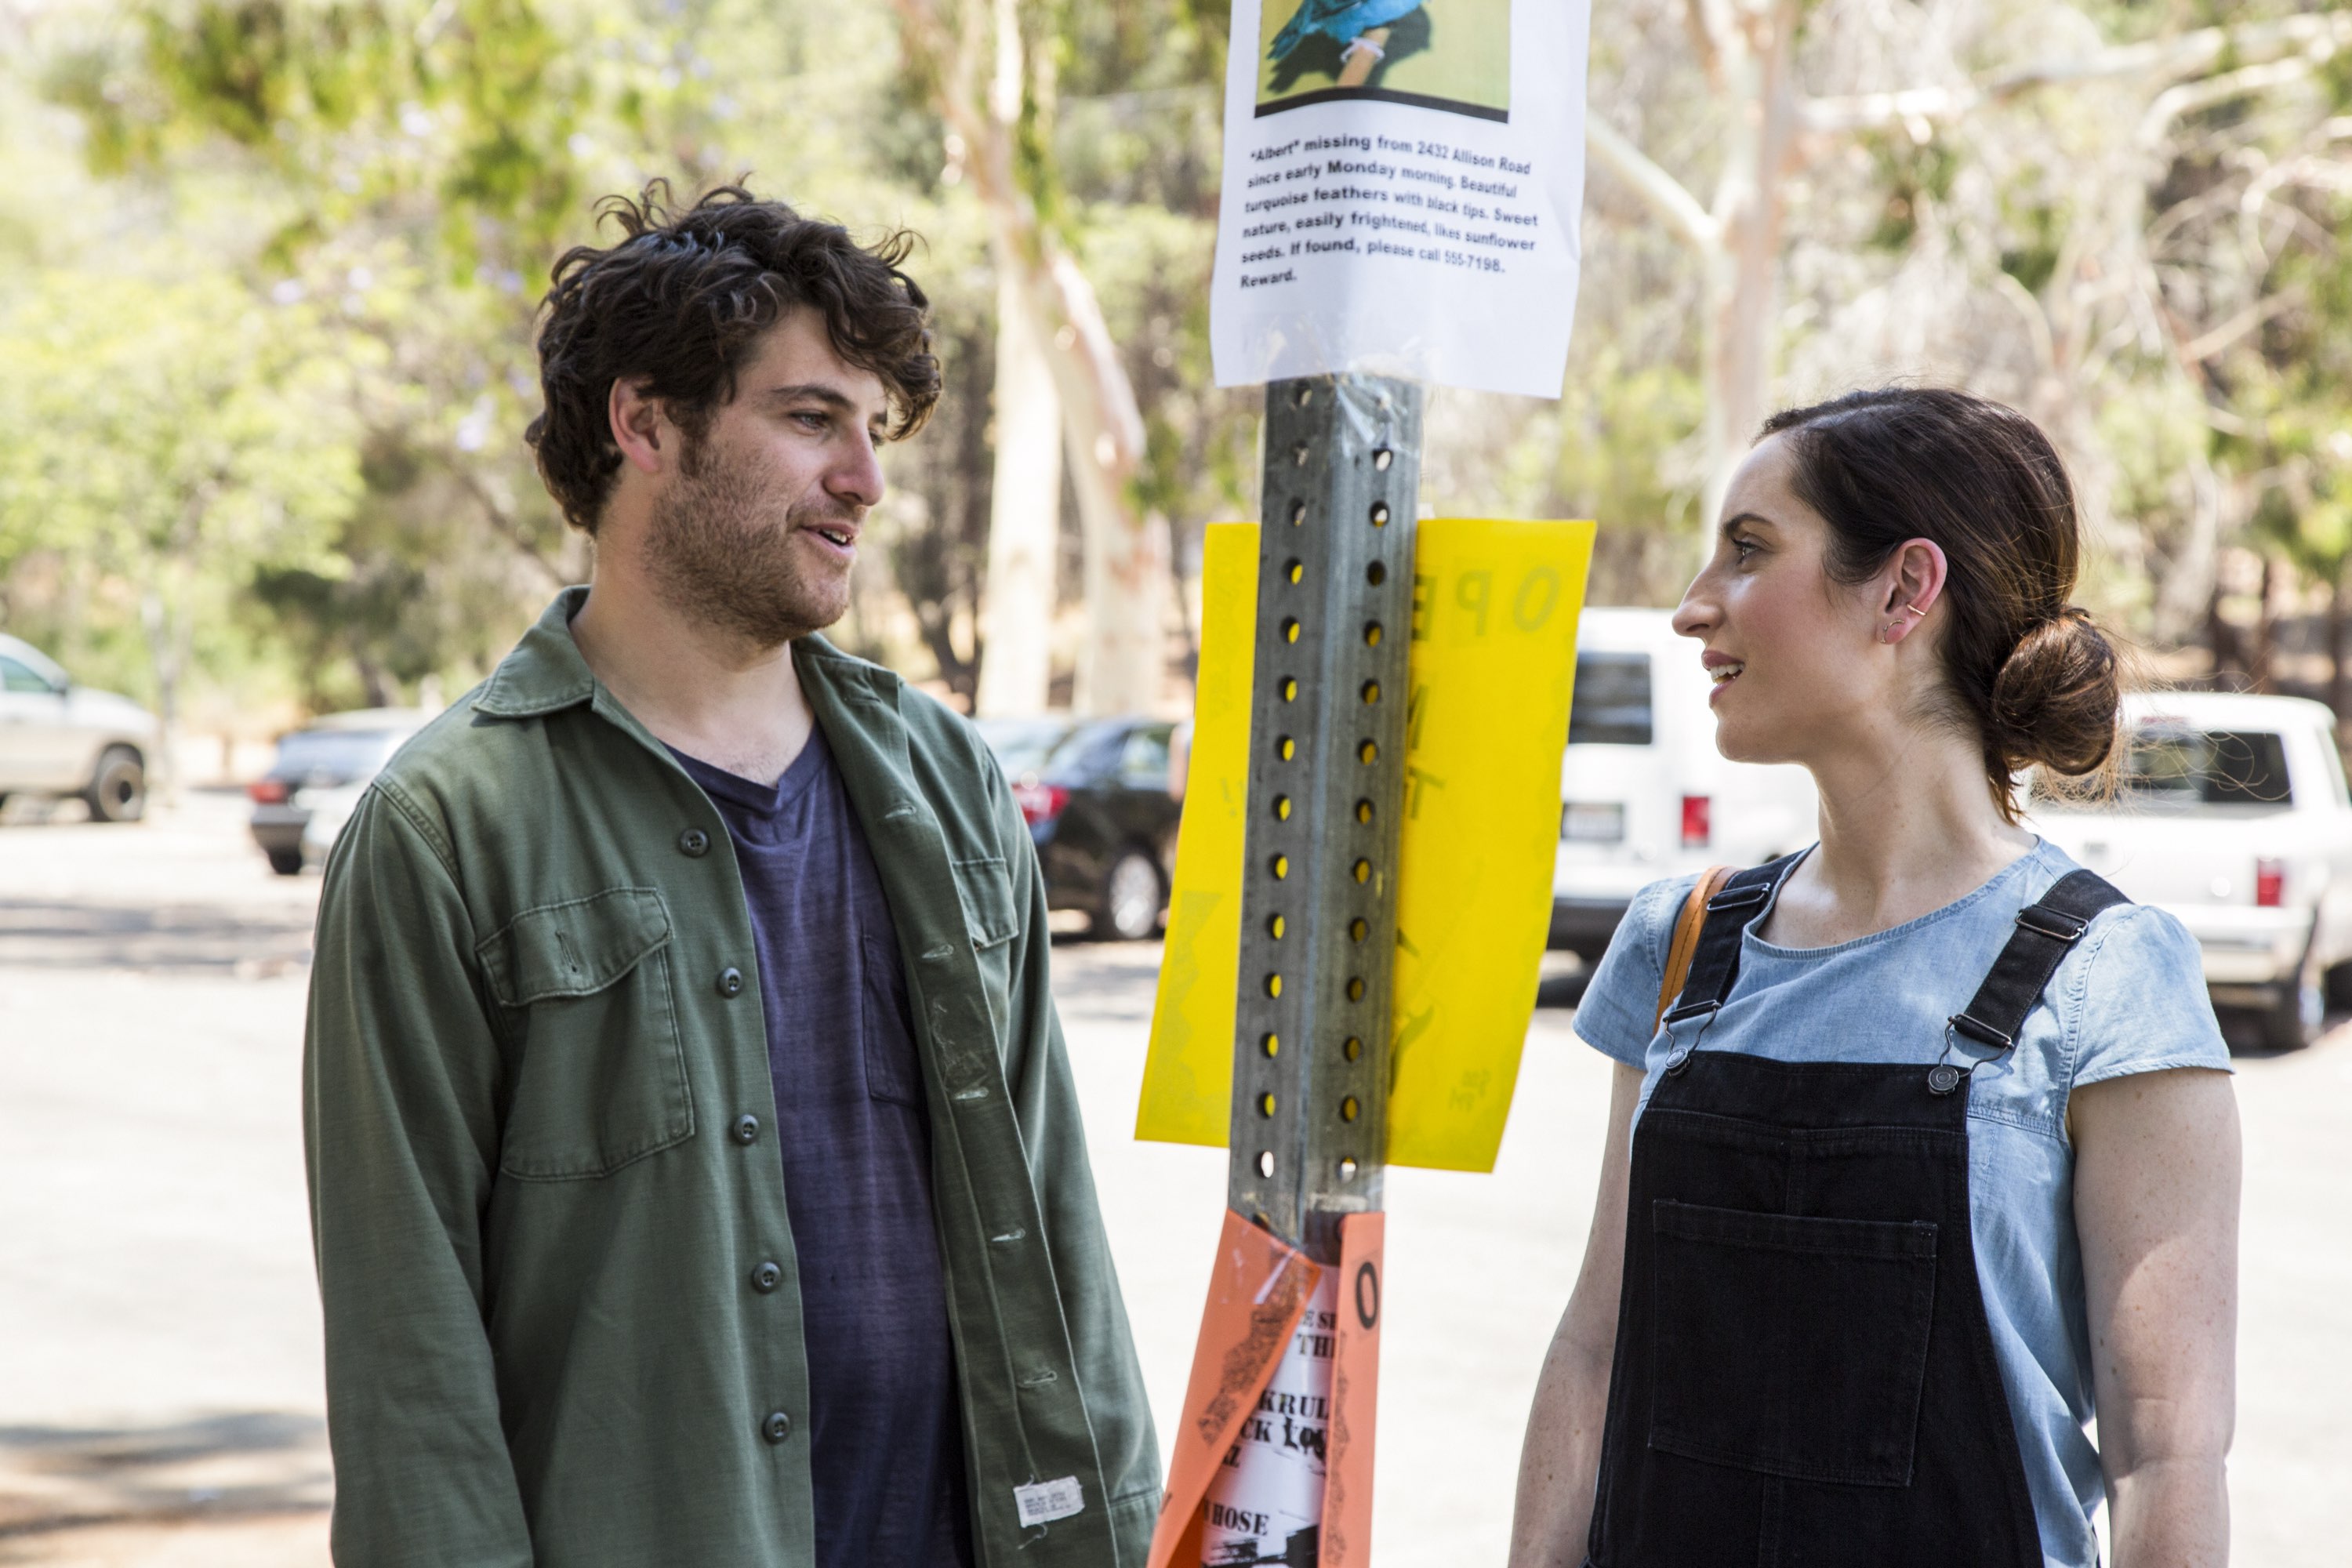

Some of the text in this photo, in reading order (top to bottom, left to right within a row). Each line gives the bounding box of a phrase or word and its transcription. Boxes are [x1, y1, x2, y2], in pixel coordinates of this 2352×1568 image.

[1304, 133, 1370, 151] missing
[1377, 134, 1412, 152] from
[1417, 140, 1449, 158] 2432
[1452, 148, 1495, 169] Allison
[1498, 156, 1531, 176] Road
[1247, 171, 1281, 188] since
[1286, 164, 1322, 180] early
[1327, 161, 1396, 179] Monday
[1461, 175, 1518, 198] Beautiful
[1245, 186, 1538, 227] turquoise feathers with black tips. Sweet
[1242, 211, 1536, 251] nature, easily frightened, likes sunflower
[1242, 246, 1285, 263] seeds.
[1290, 240, 1301, 256] If
[1305, 238, 1361, 253] found,
[1367, 239, 1415, 257] please
[1419, 249, 1441, 262] call
[1240, 268, 1298, 289] Reward.
